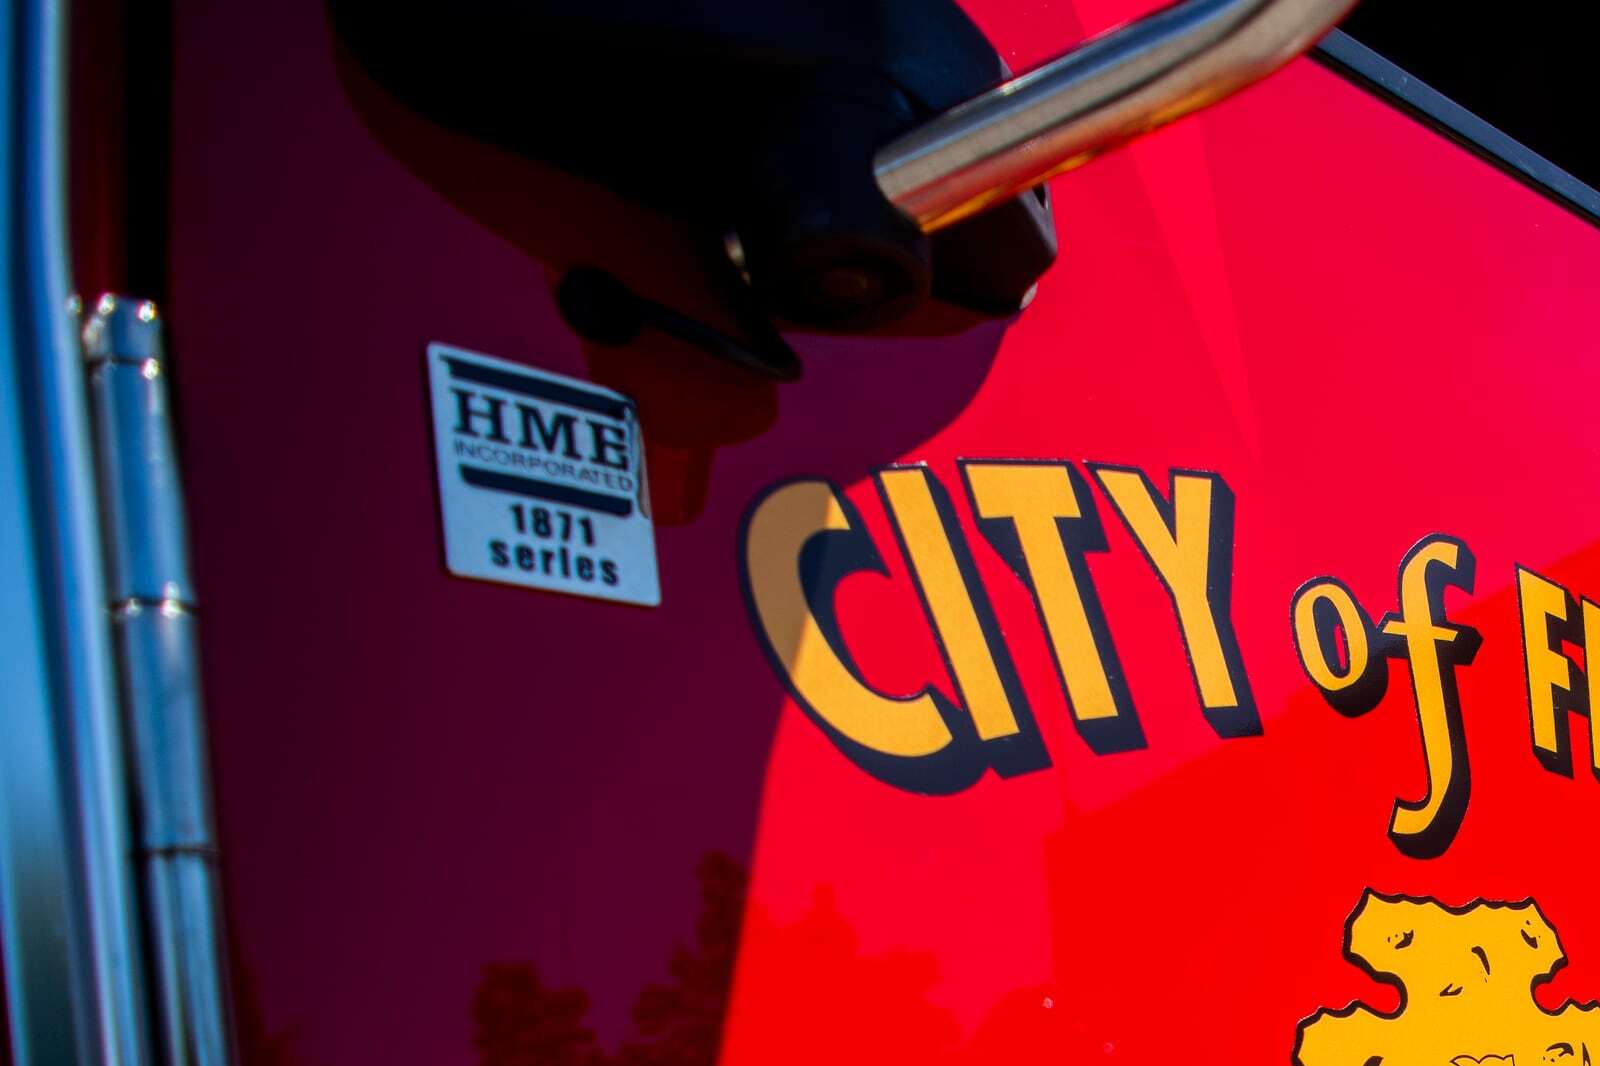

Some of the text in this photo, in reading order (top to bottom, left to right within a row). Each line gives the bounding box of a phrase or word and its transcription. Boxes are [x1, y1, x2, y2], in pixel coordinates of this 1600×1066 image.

[449, 387, 630, 471] HME
[453, 439, 633, 492] INCORPORATED
[510, 503, 596, 546] 1871
[488, 539, 621, 586] series
[736, 457, 1264, 797] CITY
[1289, 532, 1484, 860] of
